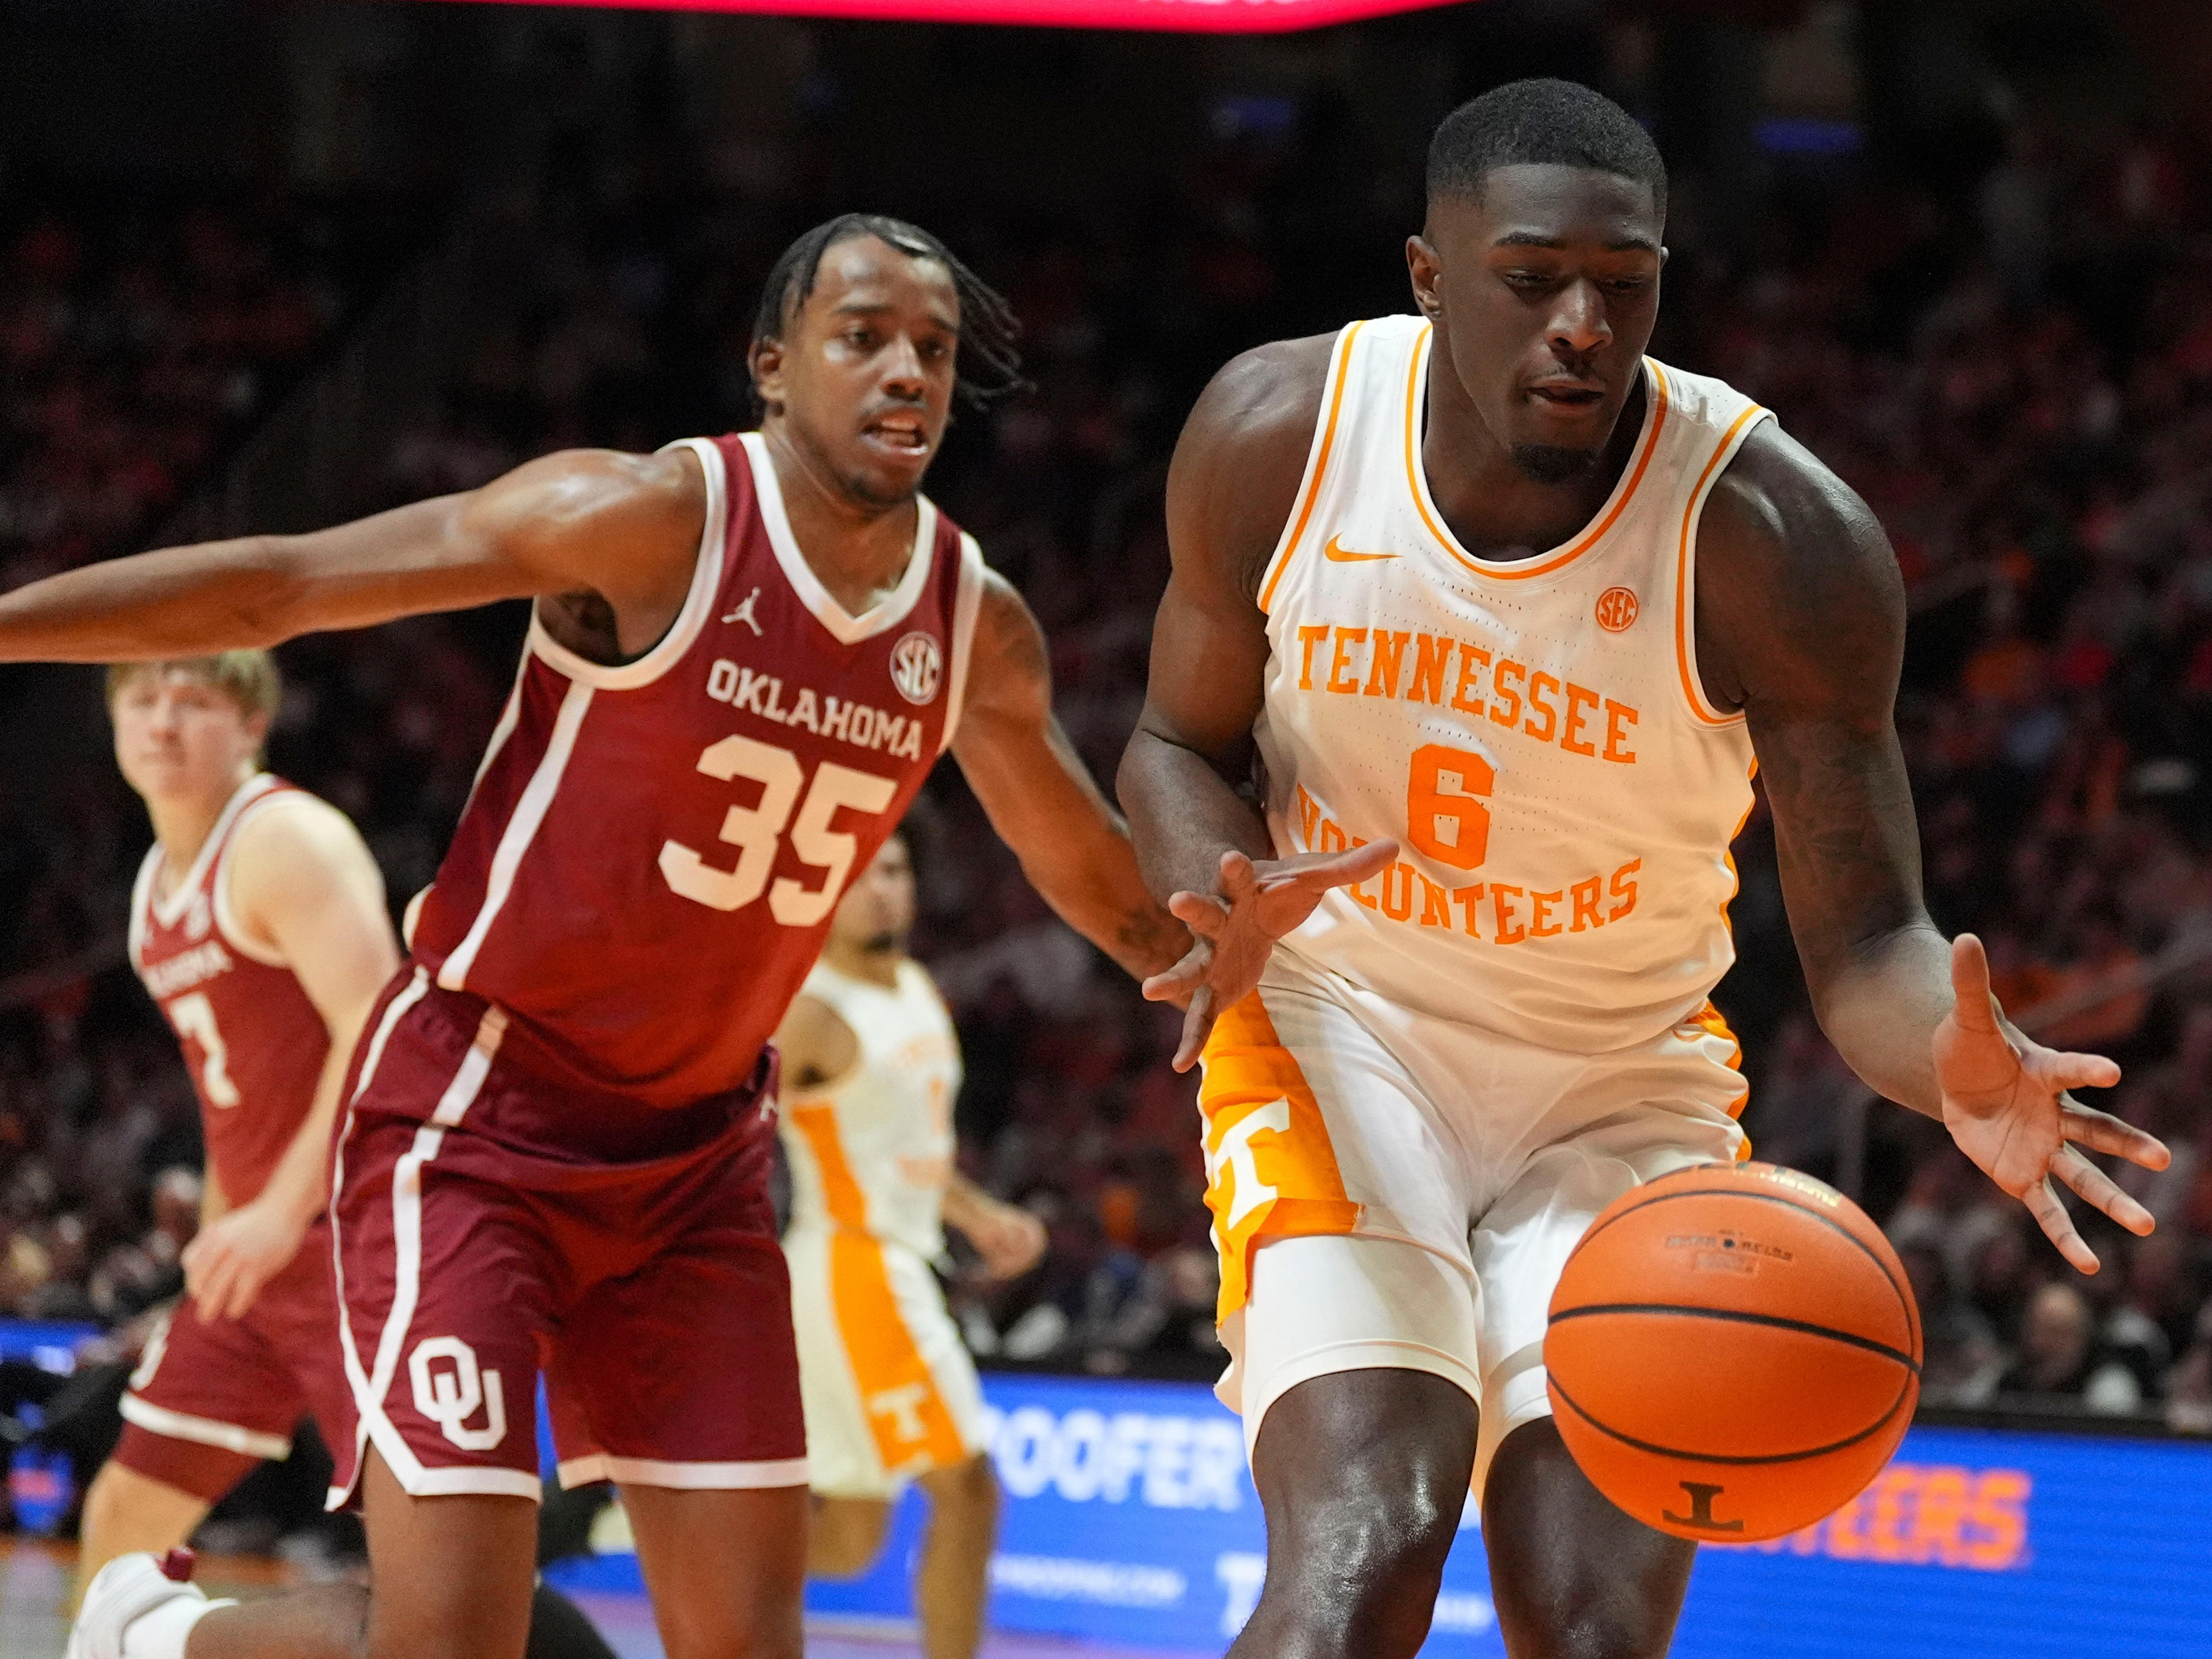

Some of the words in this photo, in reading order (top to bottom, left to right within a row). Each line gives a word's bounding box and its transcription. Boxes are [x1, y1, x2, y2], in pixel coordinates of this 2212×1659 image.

[894, 637, 941, 698] SEC
[1598, 590, 1639, 630] SEC
[707, 659, 923, 761] OKLAHOMA
[1297, 626, 1638, 764] TENNESSEE
[658, 734, 897, 927] 35
[1407, 743, 1496, 870] 6
[1212, 1095, 1289, 1231] T
[409, 1336, 507, 1451] OU
